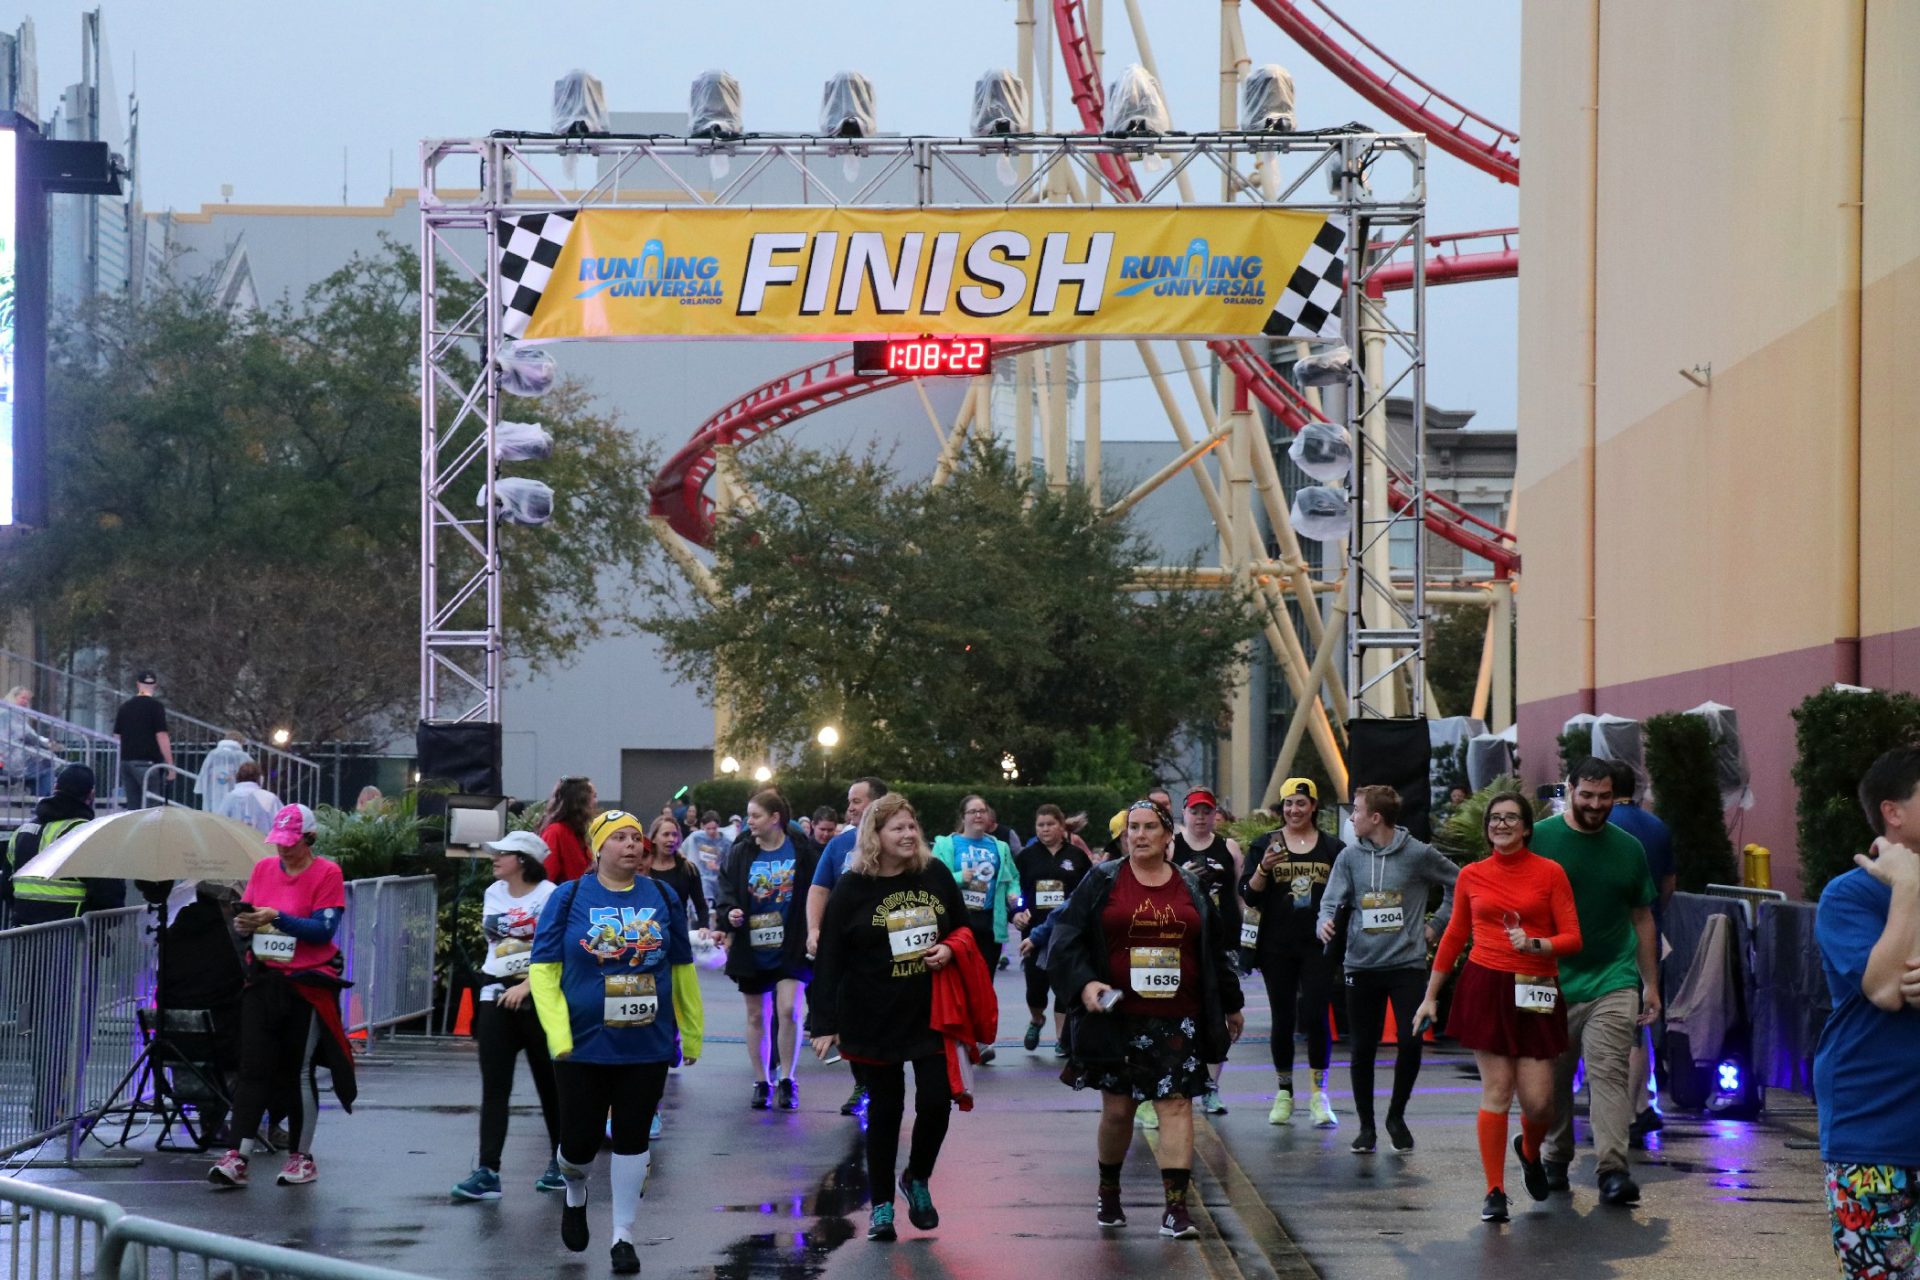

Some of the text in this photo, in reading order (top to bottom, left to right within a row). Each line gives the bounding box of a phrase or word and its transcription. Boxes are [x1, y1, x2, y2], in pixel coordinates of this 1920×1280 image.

[736, 230, 1115, 316] FINISH
[609, 280, 723, 297] UNIVERSAL
[1153, 279, 1266, 296] UNIVERSAL
[1223, 297, 1264, 305] ORLANDO
[749, 859, 796, 885] 5K
[872, 890, 945, 926] HOGWARTS
[587, 907, 664, 940] 5K
[1373, 912, 1402, 923] 1204
[758, 931, 783, 941] 1271
[905, 932, 937, 947] 1373
[1240, 928, 1257, 939] 70
[264, 941, 295, 952] 1004
[506, 958, 530, 970] 002
[892, 961, 926, 977] ALUM
[1145, 975, 1179, 986] 1636
[1529, 991, 1557, 1002] 1707
[620, 1003, 656, 1015] 1391
